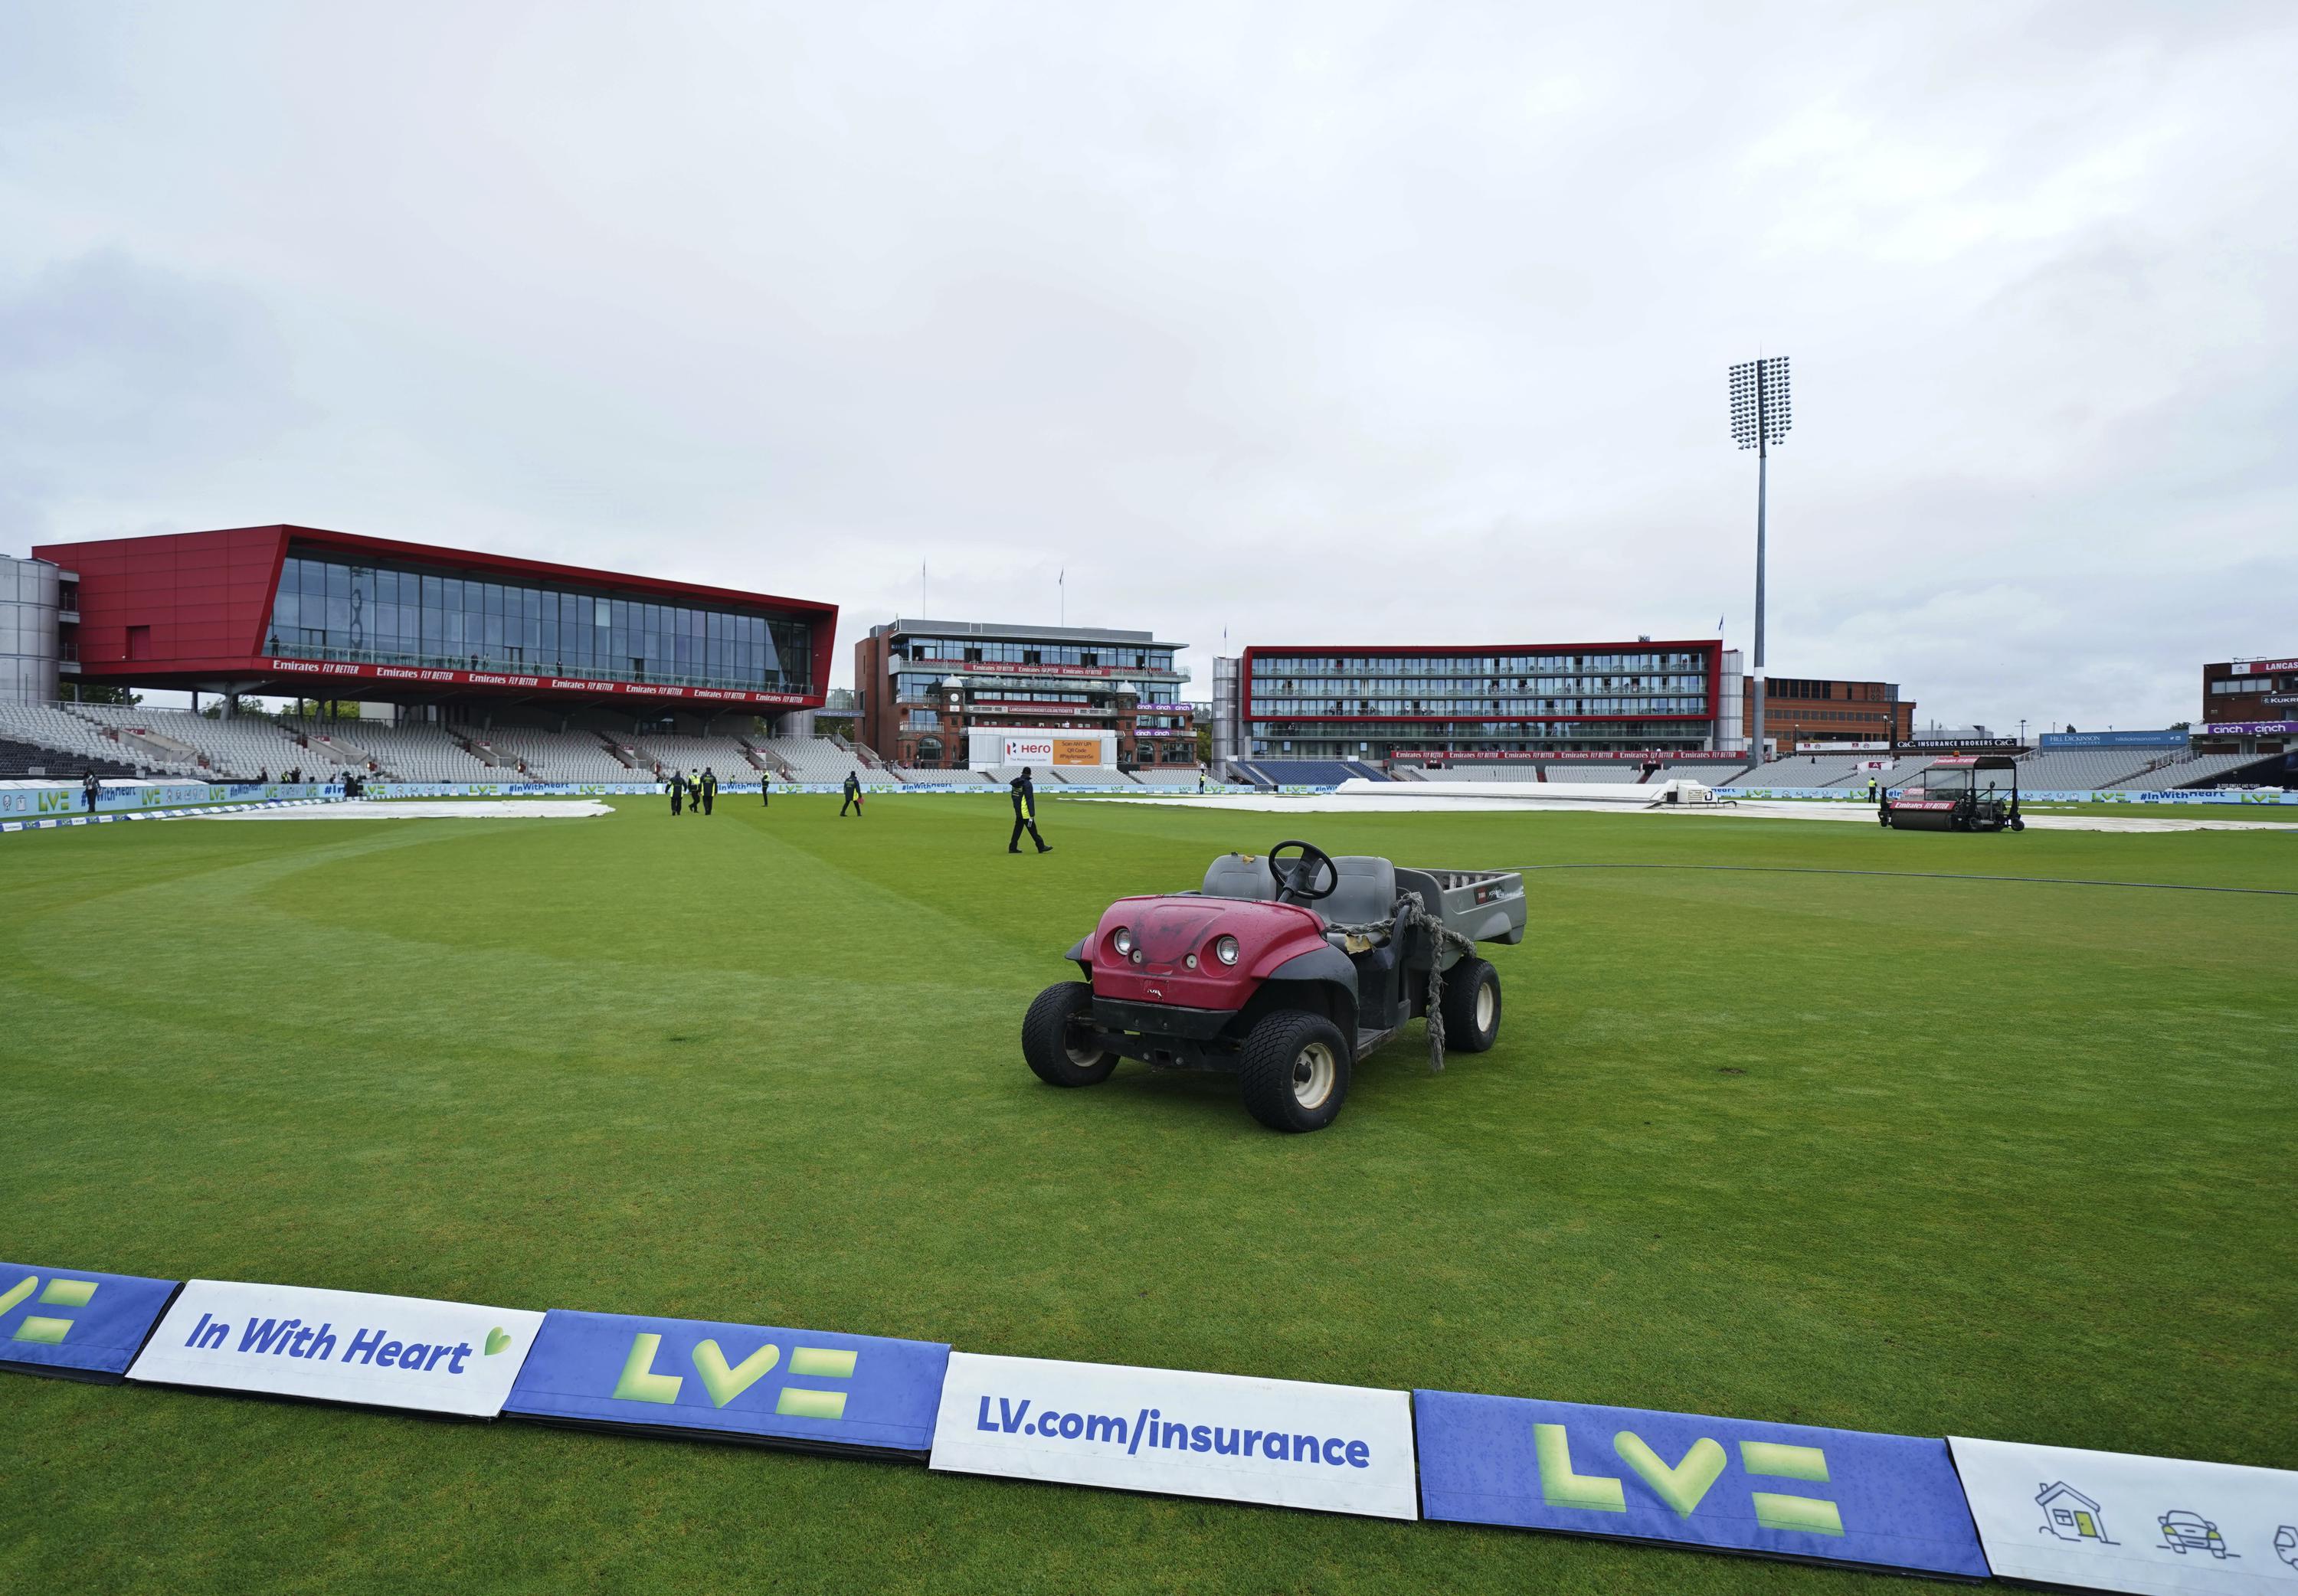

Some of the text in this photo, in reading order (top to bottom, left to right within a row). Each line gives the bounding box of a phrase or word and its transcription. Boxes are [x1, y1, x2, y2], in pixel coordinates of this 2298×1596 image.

[273, 660, 359, 674] Emirates FLY BETTER
[377, 668, 453, 680] Emirates FLY BETTER
[469, 674, 538, 686] Emirates FLY BETTER
[552, 680, 584, 689] Emirates
[627, 685, 656, 693] Emirates
[694, 690, 722, 698] Emirates
[2213, 724, 2286, 734] cinch cinch
[81, 787, 136, 806] #WithHeart
[2140, 791, 2225, 800] #InWithHeart
[184, 1313, 473, 1375] In With Heart
[977, 1395, 1370, 1469] LV.com/insurance
